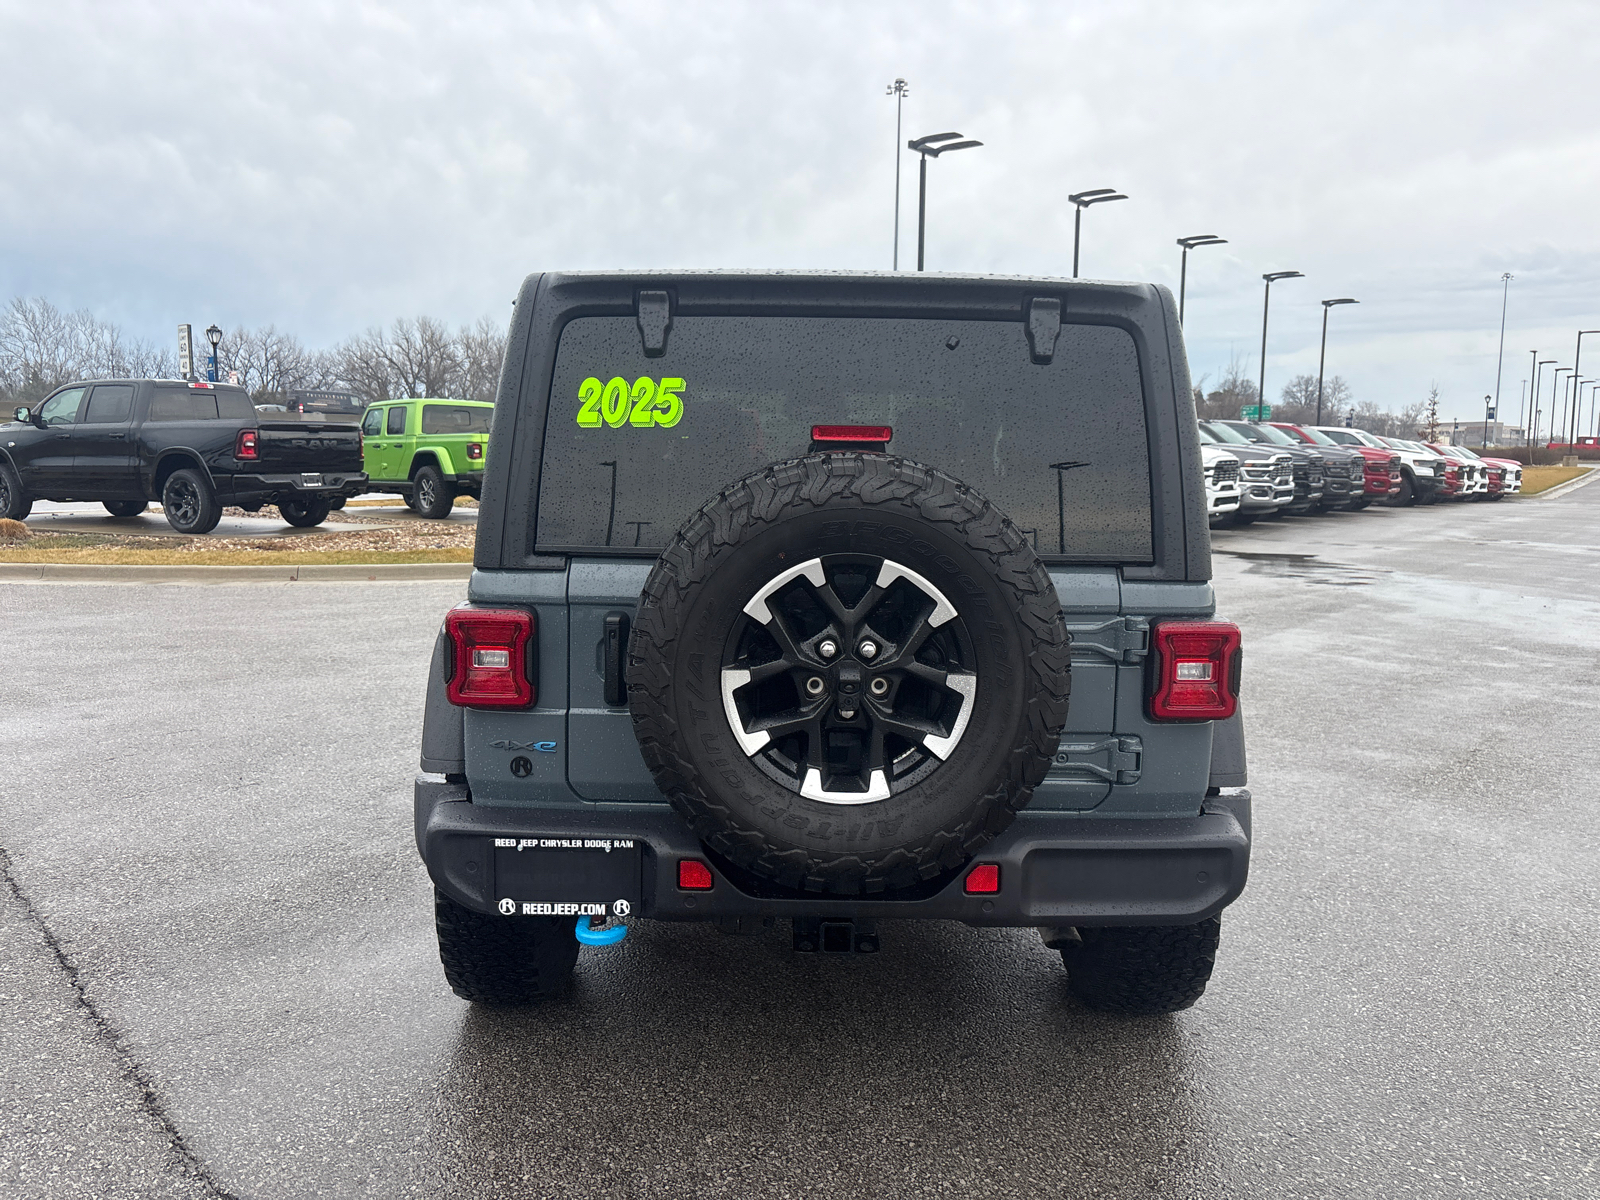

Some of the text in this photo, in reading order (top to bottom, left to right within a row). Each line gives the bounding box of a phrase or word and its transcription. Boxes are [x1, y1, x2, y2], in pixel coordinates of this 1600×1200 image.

[577, 376, 687, 428] 2025
[291, 439, 338, 450] RAM
[817, 519, 1013, 689] BFGoodrich
[495, 838, 634, 849] REED JEEP CHRYSLER DODGE RAM
[522, 903, 606, 915] REEDJEEP.COM
